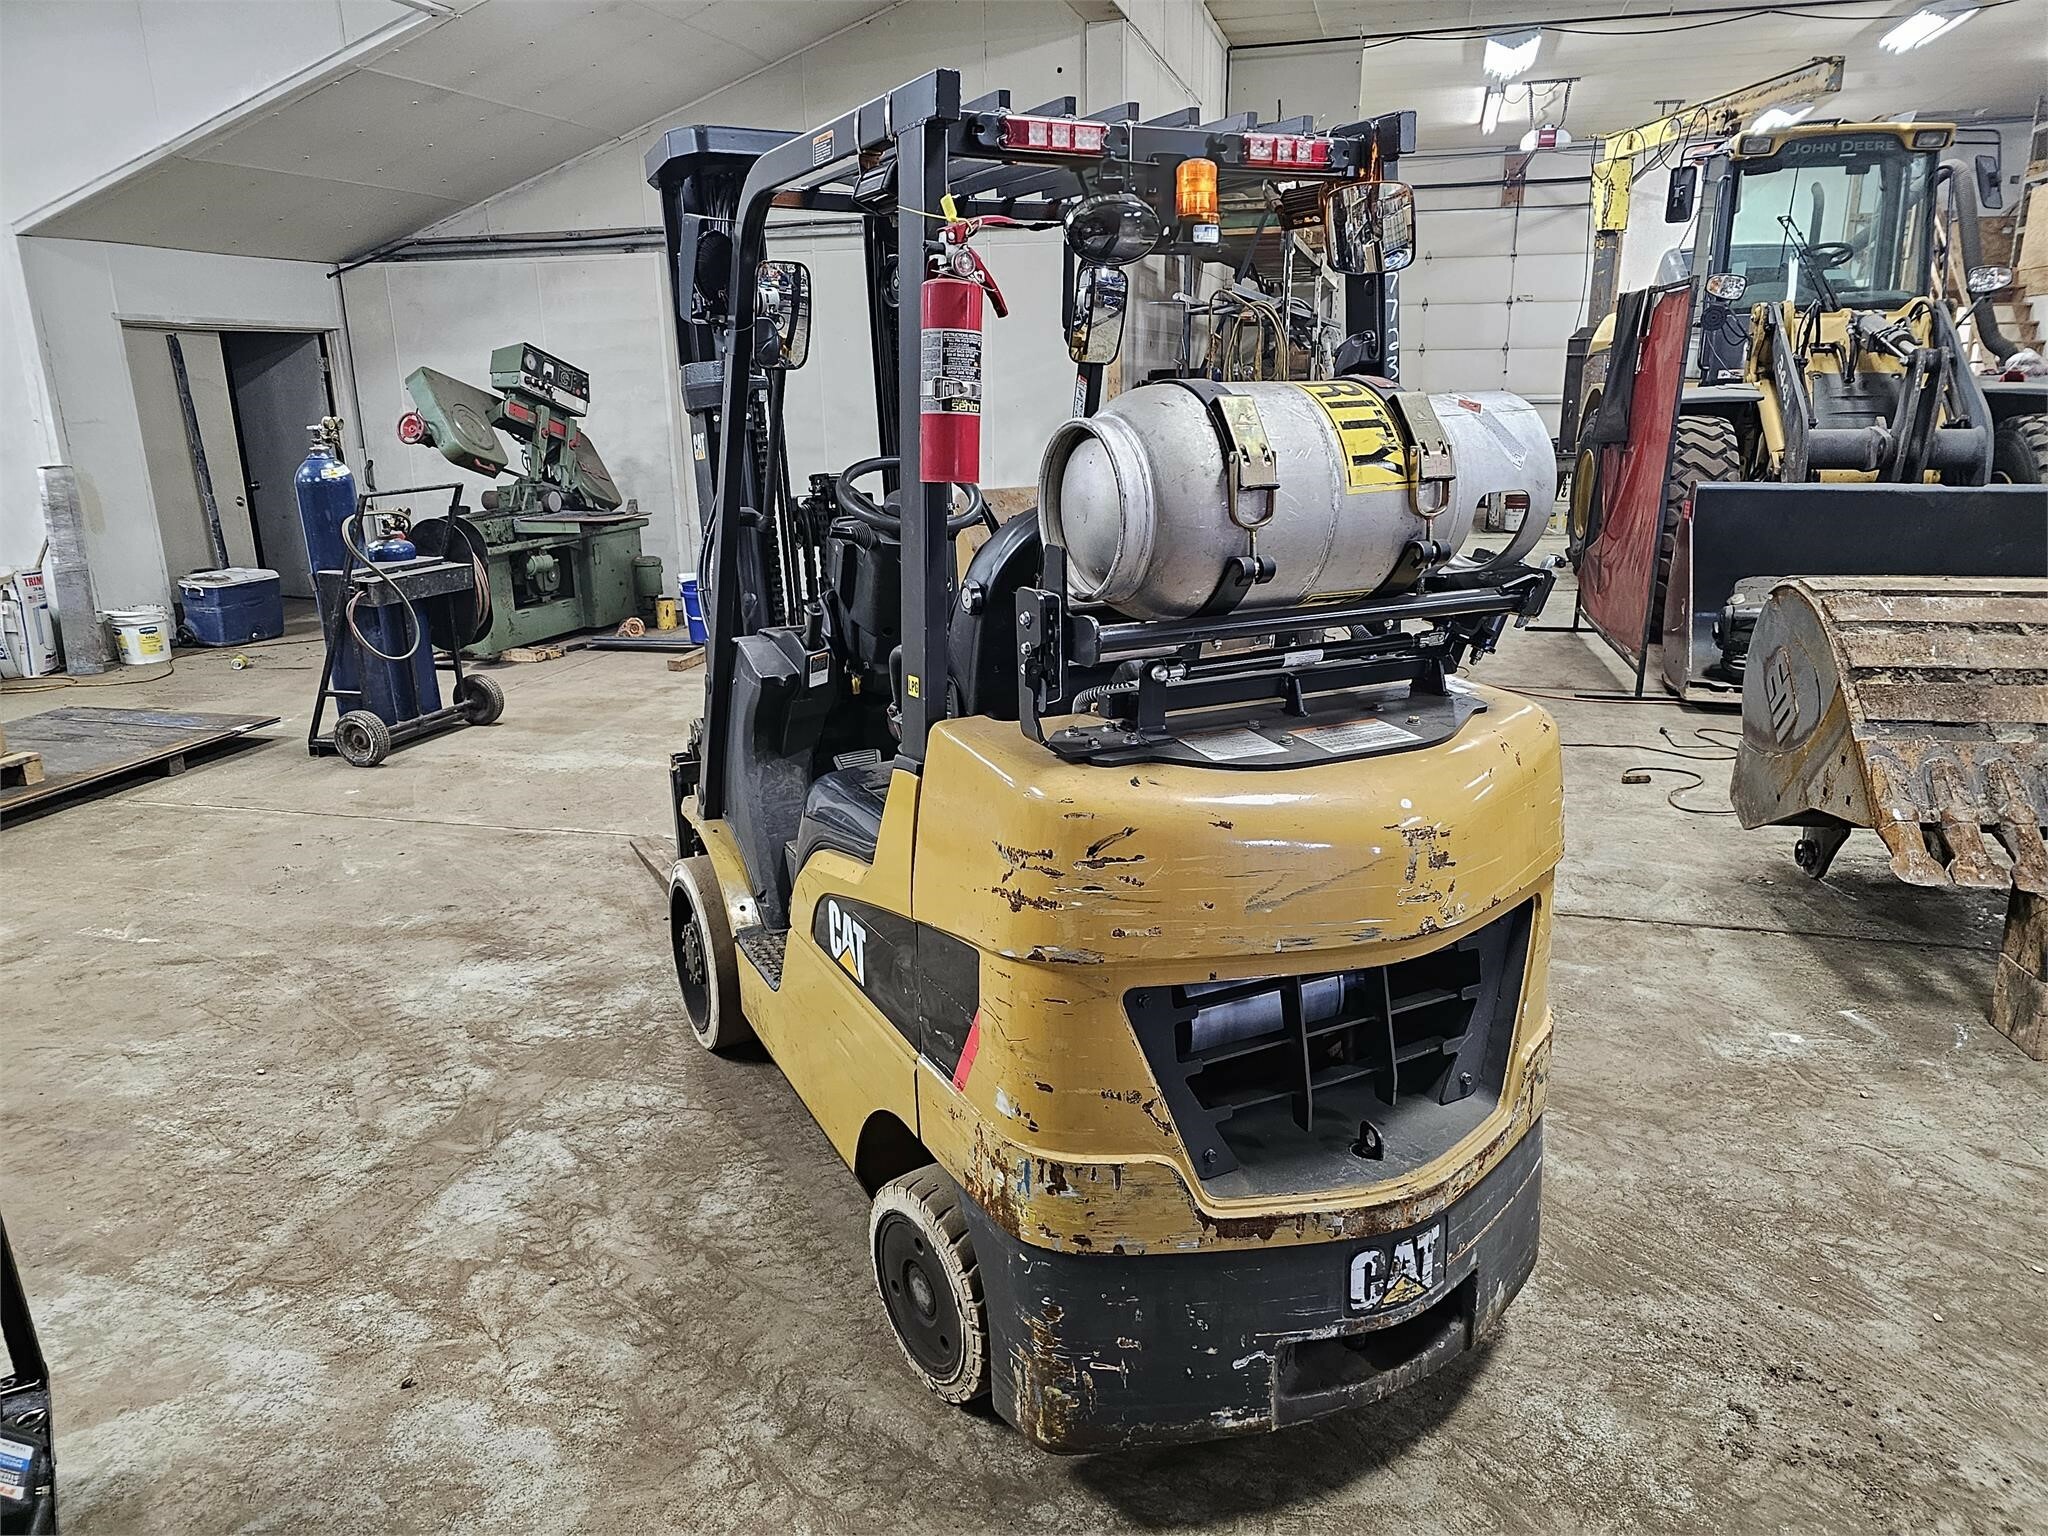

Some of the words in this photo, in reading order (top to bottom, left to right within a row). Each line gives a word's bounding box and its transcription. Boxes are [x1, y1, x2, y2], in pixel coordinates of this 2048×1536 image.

[1789, 142, 1836, 155] JOHN
[1840, 140, 1896, 152] DEERE
[828, 899, 867, 987] CAT
[1350, 1223, 1440, 1310] CAT
